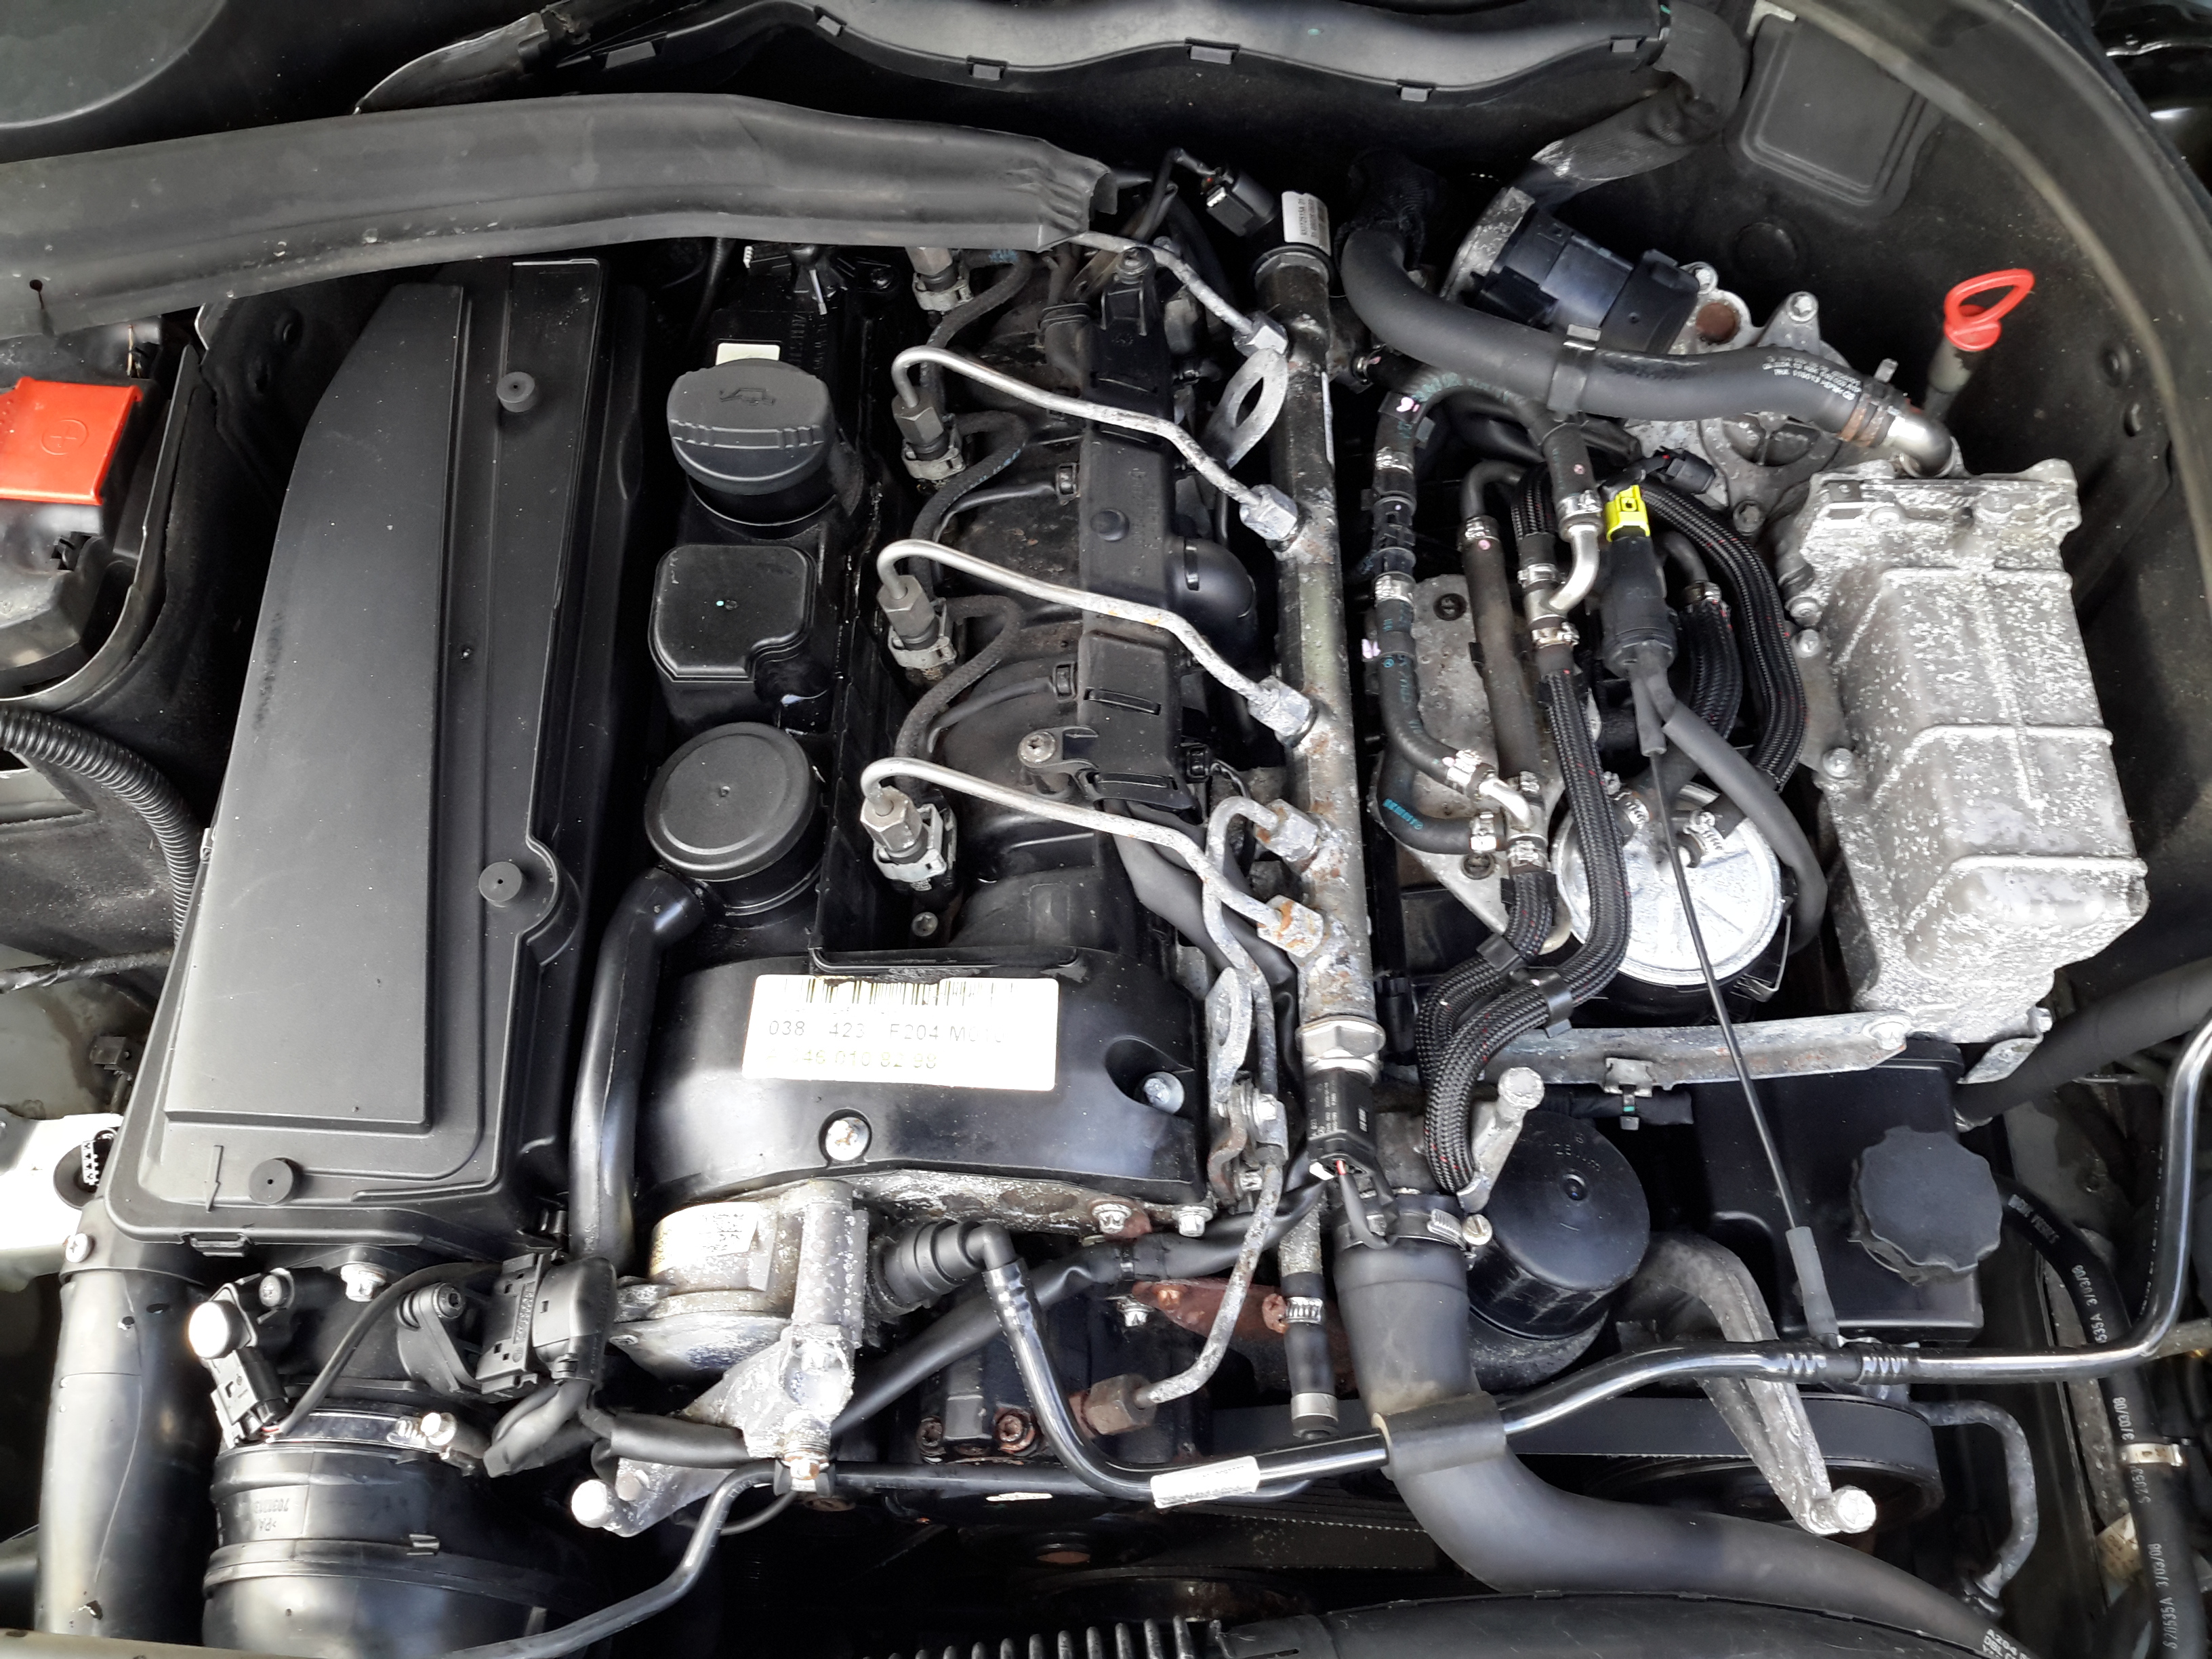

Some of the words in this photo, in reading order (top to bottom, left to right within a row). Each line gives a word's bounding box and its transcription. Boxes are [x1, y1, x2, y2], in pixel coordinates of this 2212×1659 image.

[769, 1020, 806, 1037] 038
[828, 1022, 865, 1039] 423
[2071, 1264, 2099, 1307] 3/03/08
[2112, 1396, 2135, 1441] 3/03/08
[2147, 1542, 2170, 1588] 3/03/08
